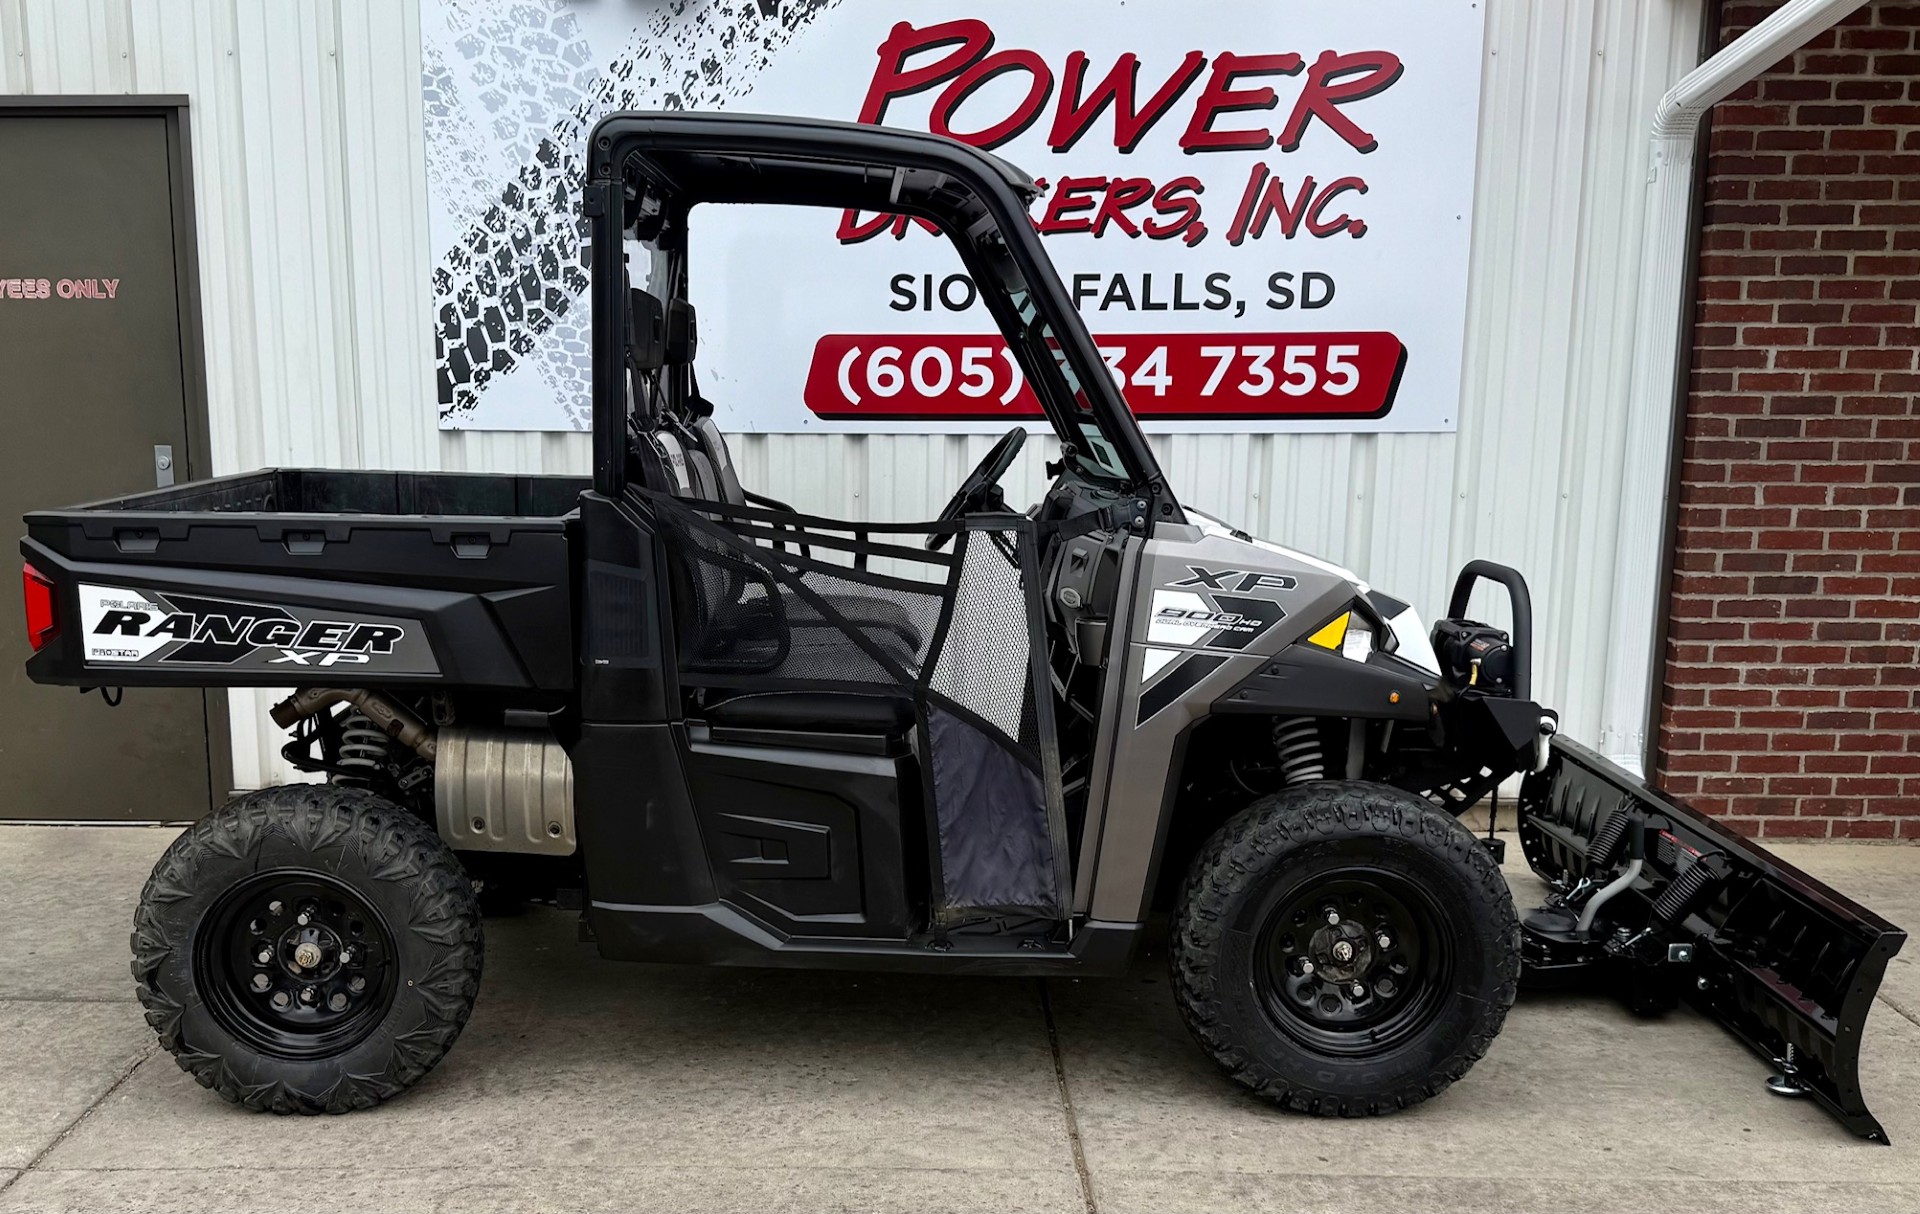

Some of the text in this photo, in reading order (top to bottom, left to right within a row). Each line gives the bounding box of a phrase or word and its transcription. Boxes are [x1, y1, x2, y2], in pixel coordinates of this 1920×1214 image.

[857, 18, 1405, 154] POWER
[1226, 162, 1369, 246] INC.
[56, 278, 120, 299] ONLY
[1072, 272, 1247, 318] FALLS,
[1266, 271, 1336, 311] SD
[837, 344, 1024, 406] (605)
[1200, 344, 1361, 397] 7355
[1164, 564, 1299, 594] XP
[99, 599, 160, 612] POLARIS
[92, 609, 405, 655] RANGER
[91, 648, 140, 658] PROSTAR
[265, 649, 371, 667] XP
